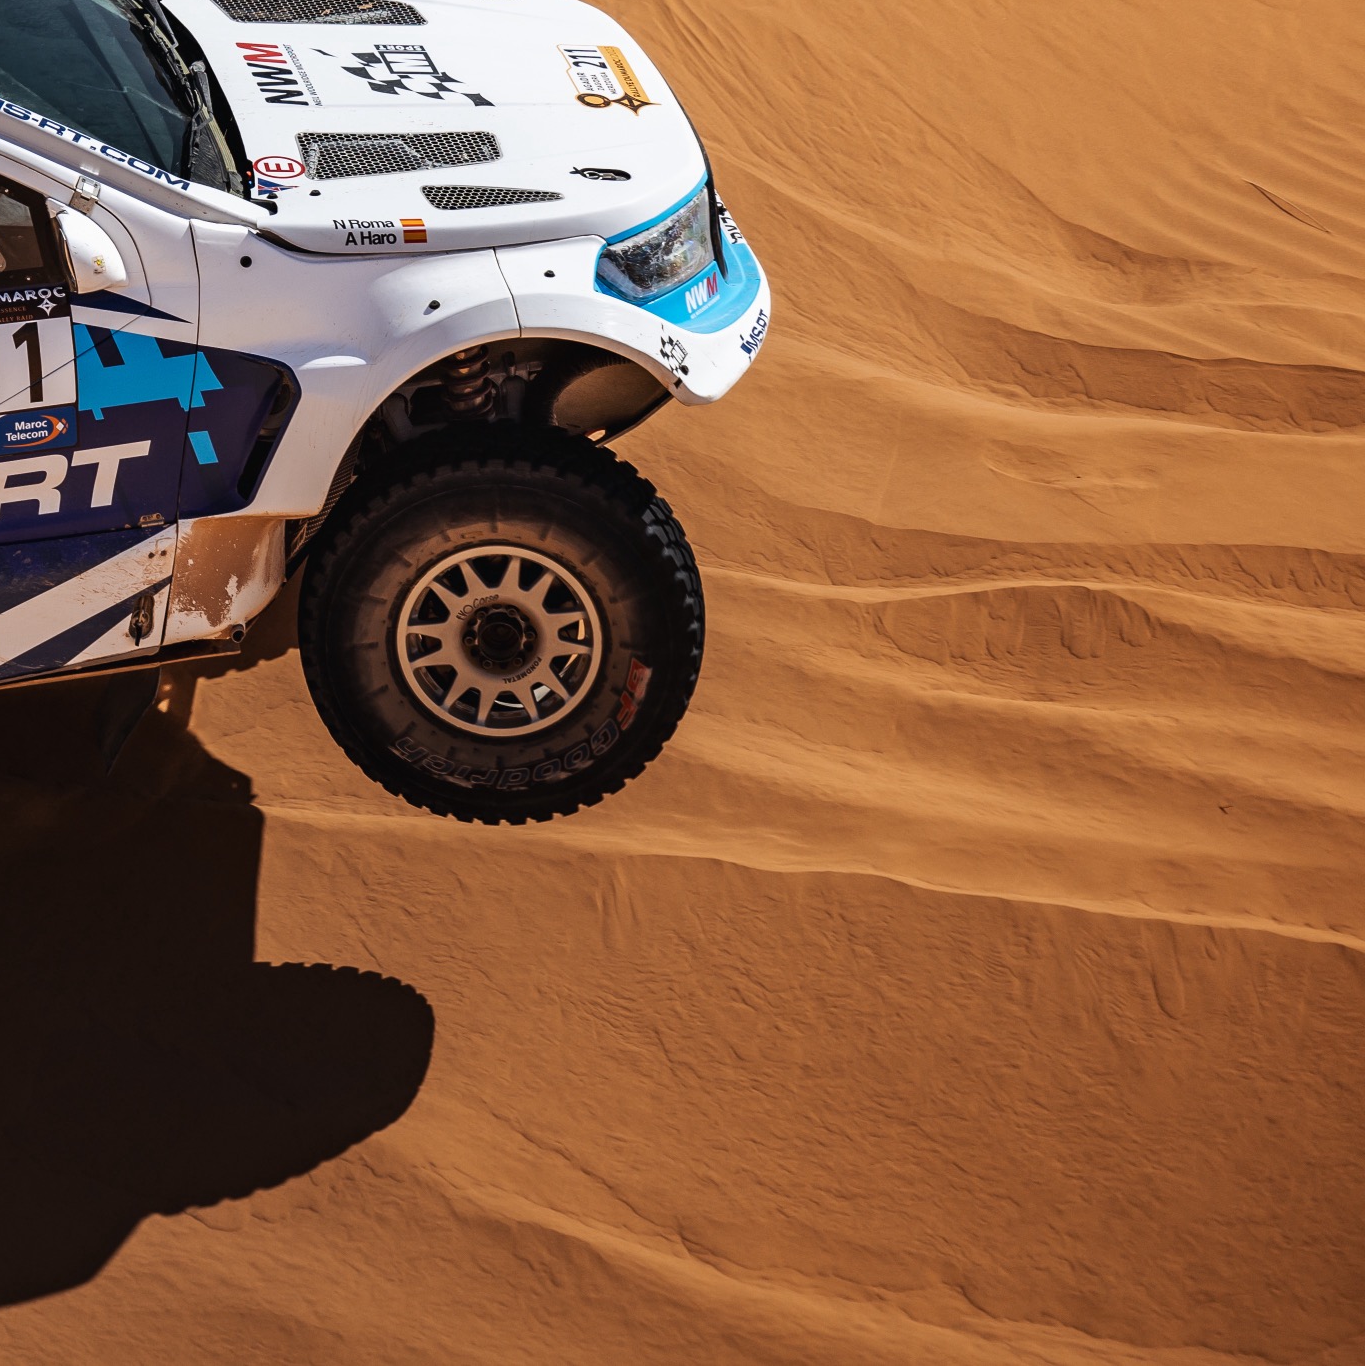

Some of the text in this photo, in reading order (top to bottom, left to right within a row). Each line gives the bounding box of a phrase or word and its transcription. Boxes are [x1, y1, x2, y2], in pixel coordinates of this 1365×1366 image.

[563, 49, 608, 69] 211
[235, 42, 310, 106] NWM
[333, 219, 395, 230] N Roma
[345, 232, 397, 246] A Haro
[685, 272, 717, 314] NWM
[17, 314, 34, 322] RAID
[14, 419, 48, 431] Maroc
[5, 430, 49, 442] Telecom
[502, 656, 542, 684] FONDMETAL
